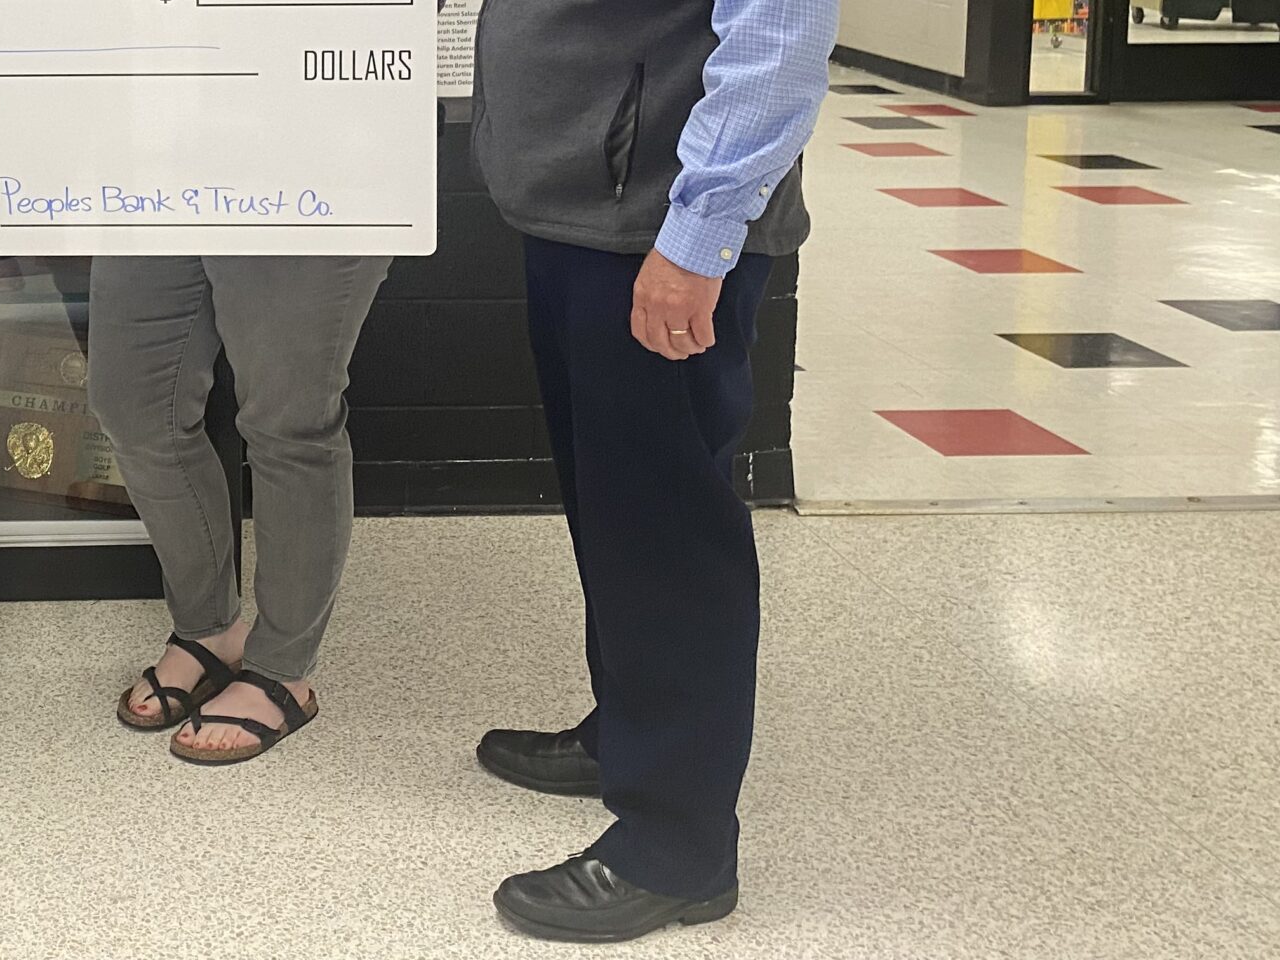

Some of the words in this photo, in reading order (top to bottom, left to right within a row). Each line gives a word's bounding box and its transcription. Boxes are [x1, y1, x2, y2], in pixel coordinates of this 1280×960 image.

[303, 50, 413, 82] DOLLARS
[102, 185, 176, 213] Bank
[204, 186, 289, 216] Trust
[297, 188, 334, 218] Co.
